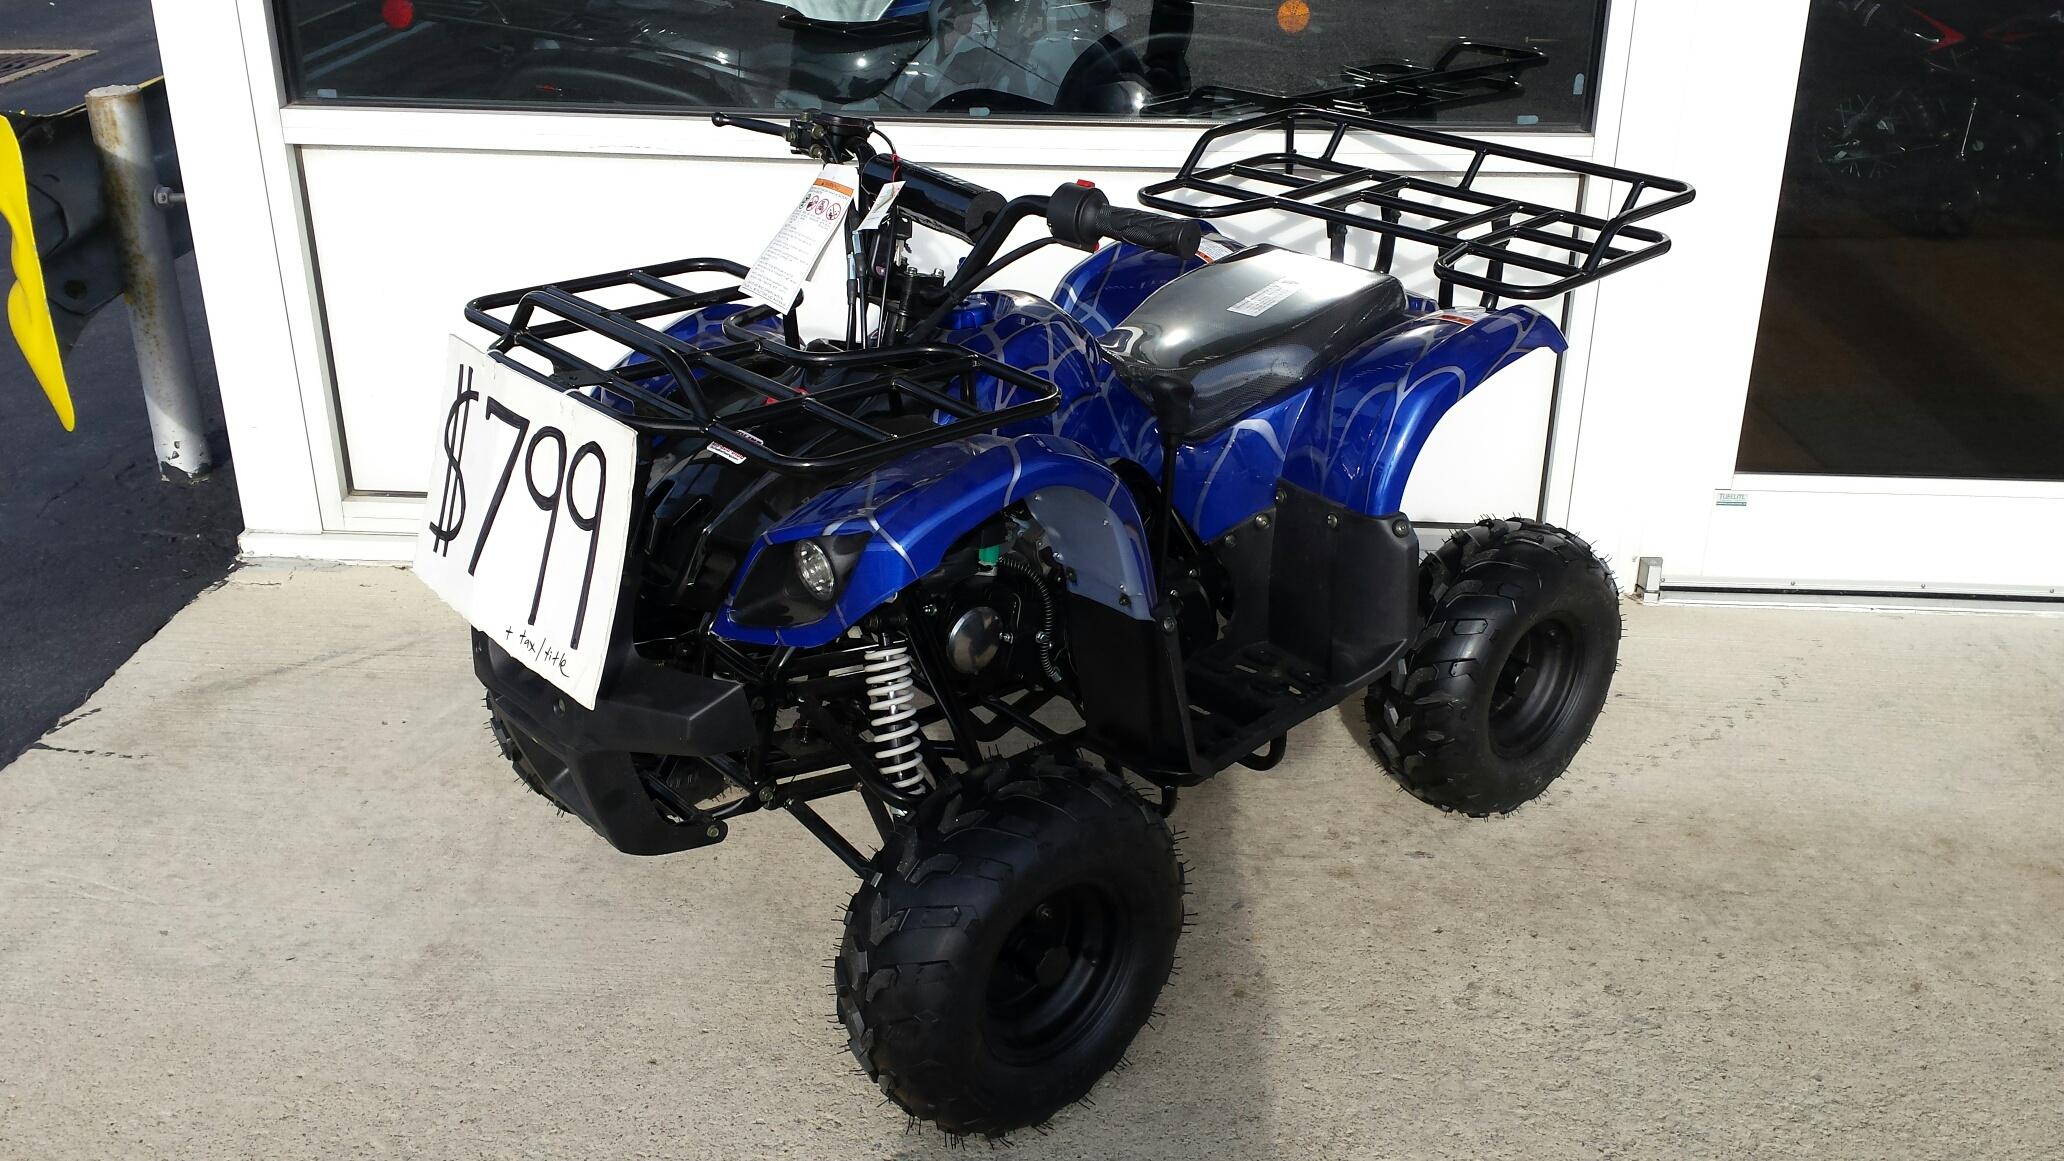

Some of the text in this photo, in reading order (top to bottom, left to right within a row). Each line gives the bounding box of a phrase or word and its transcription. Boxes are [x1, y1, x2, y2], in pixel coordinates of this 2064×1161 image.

[429, 364, 607, 650] $799
[505, 625, 570, 678] + tax/title
